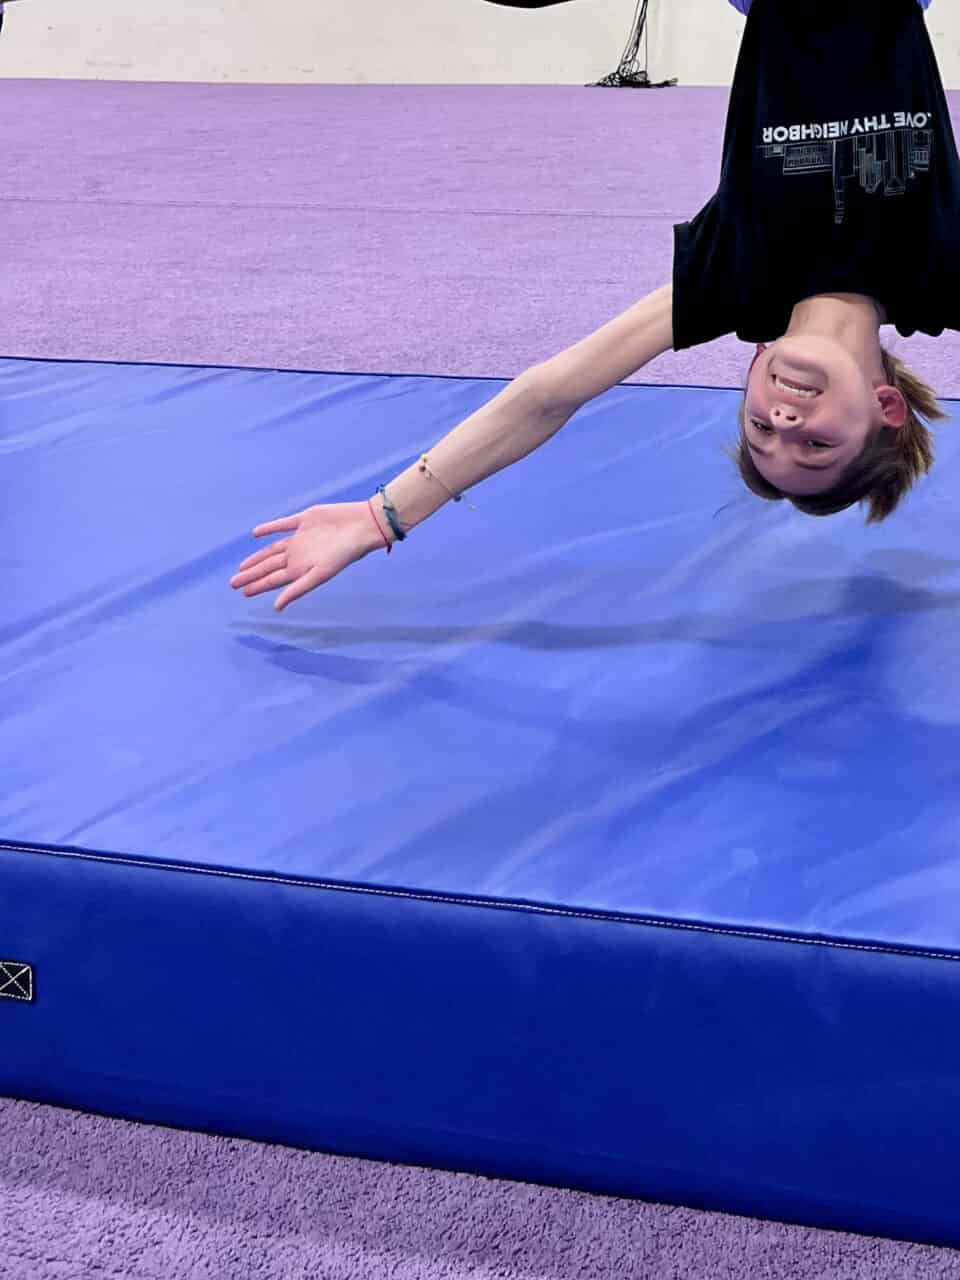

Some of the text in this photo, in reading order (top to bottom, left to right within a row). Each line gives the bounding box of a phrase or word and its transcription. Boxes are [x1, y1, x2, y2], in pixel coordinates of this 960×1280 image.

[763, 112, 931, 143] OVE THY NEIGHBOR
